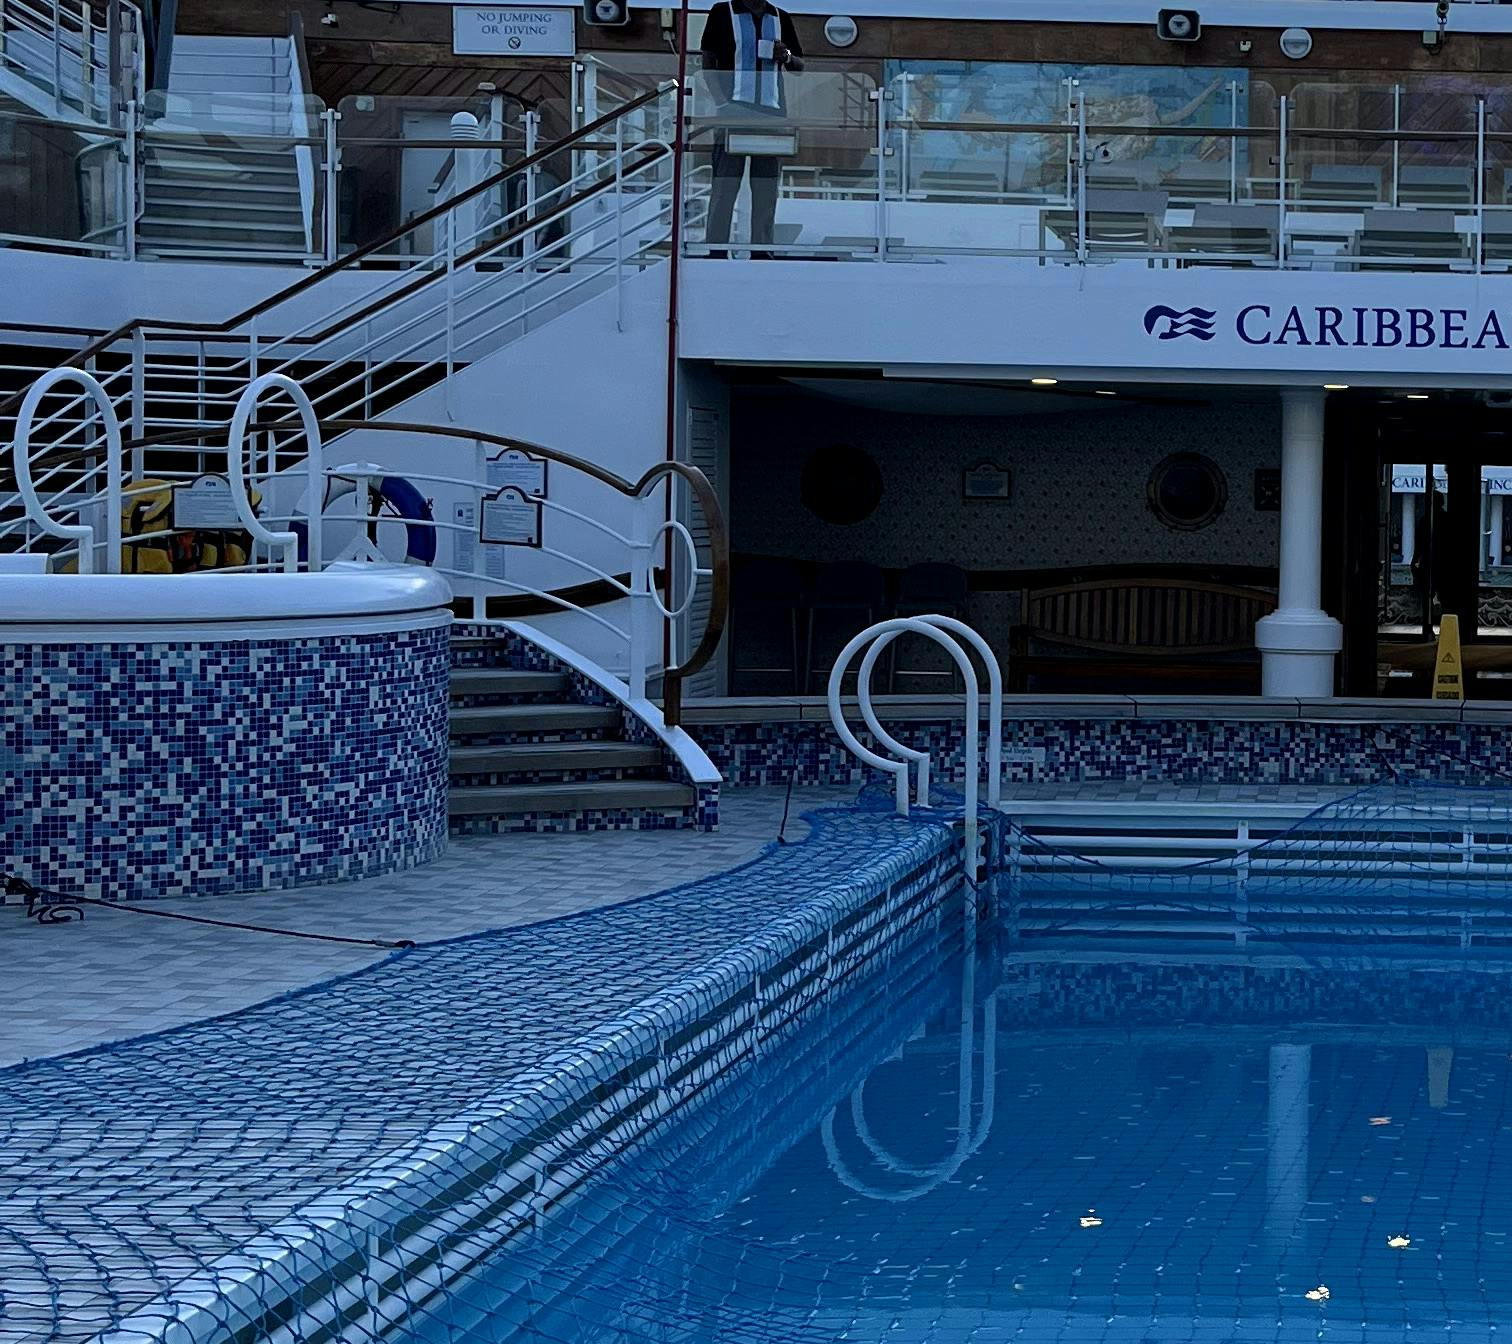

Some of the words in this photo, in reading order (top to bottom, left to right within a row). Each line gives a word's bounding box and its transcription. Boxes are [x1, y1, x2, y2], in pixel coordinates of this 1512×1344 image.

[476, 12, 496, 23] NO
[498, 13, 552, 24] JUMPING
[481, 25, 500, 35] OR
[503, 25, 548, 36] DIVING
